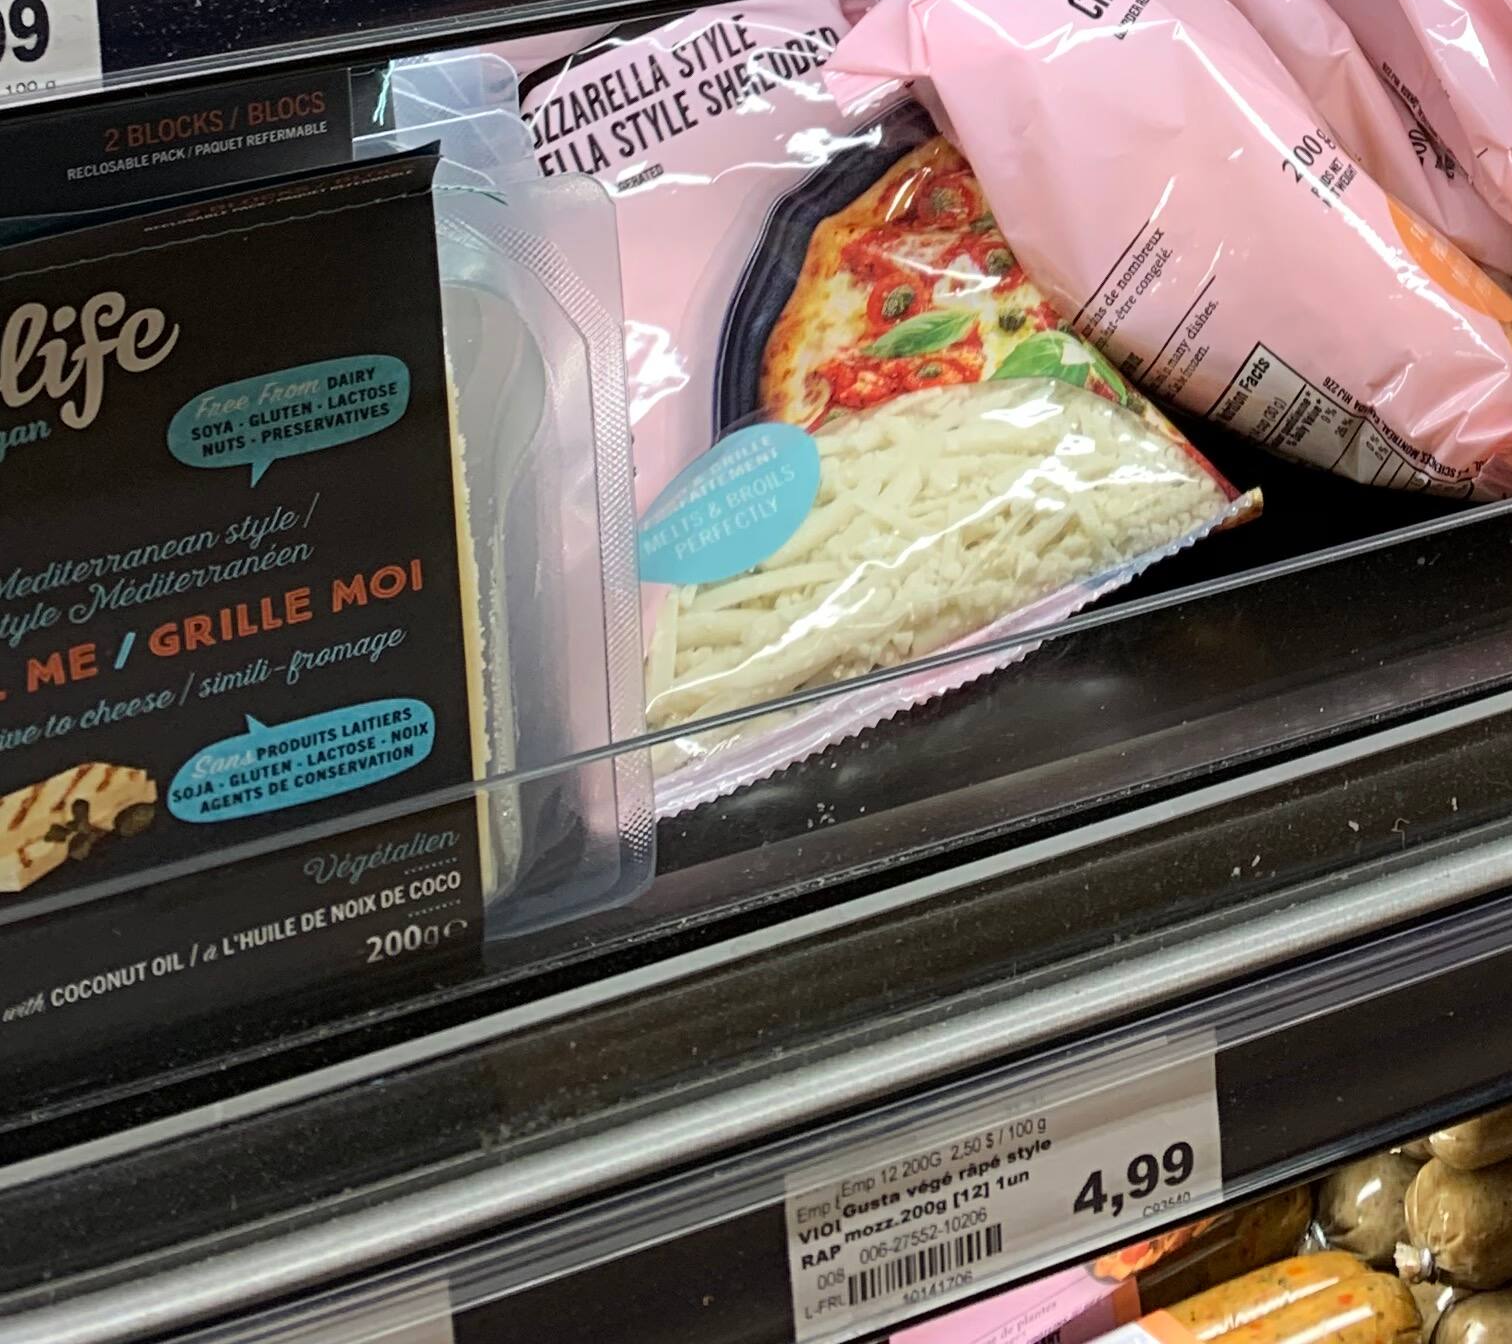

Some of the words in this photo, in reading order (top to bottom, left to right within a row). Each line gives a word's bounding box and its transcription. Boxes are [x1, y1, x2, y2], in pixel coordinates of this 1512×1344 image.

[672, 14, 758, 80] STYLE
[104, 130, 119, 153] 2
[127, 110, 224, 149] BLOCKS
[248, 90, 326, 126] BLOCS
[611, 89, 699, 159] STYLE
[250, 402, 312, 427] GLUTEN
[148, 586, 312, 659] GRILLE
[331, 558, 425, 614] MOI
[50, 960, 150, 1009] COCONUT
[152, 948, 184, 978] OIL
[843, 1189, 901, 1219] Gusta
[905, 1170, 953, 1198] végé
[958, 1156, 1001, 1185] râpé
[1006, 1135, 1052, 1165] style
[1073, 1141, 1195, 1219] 4,99
